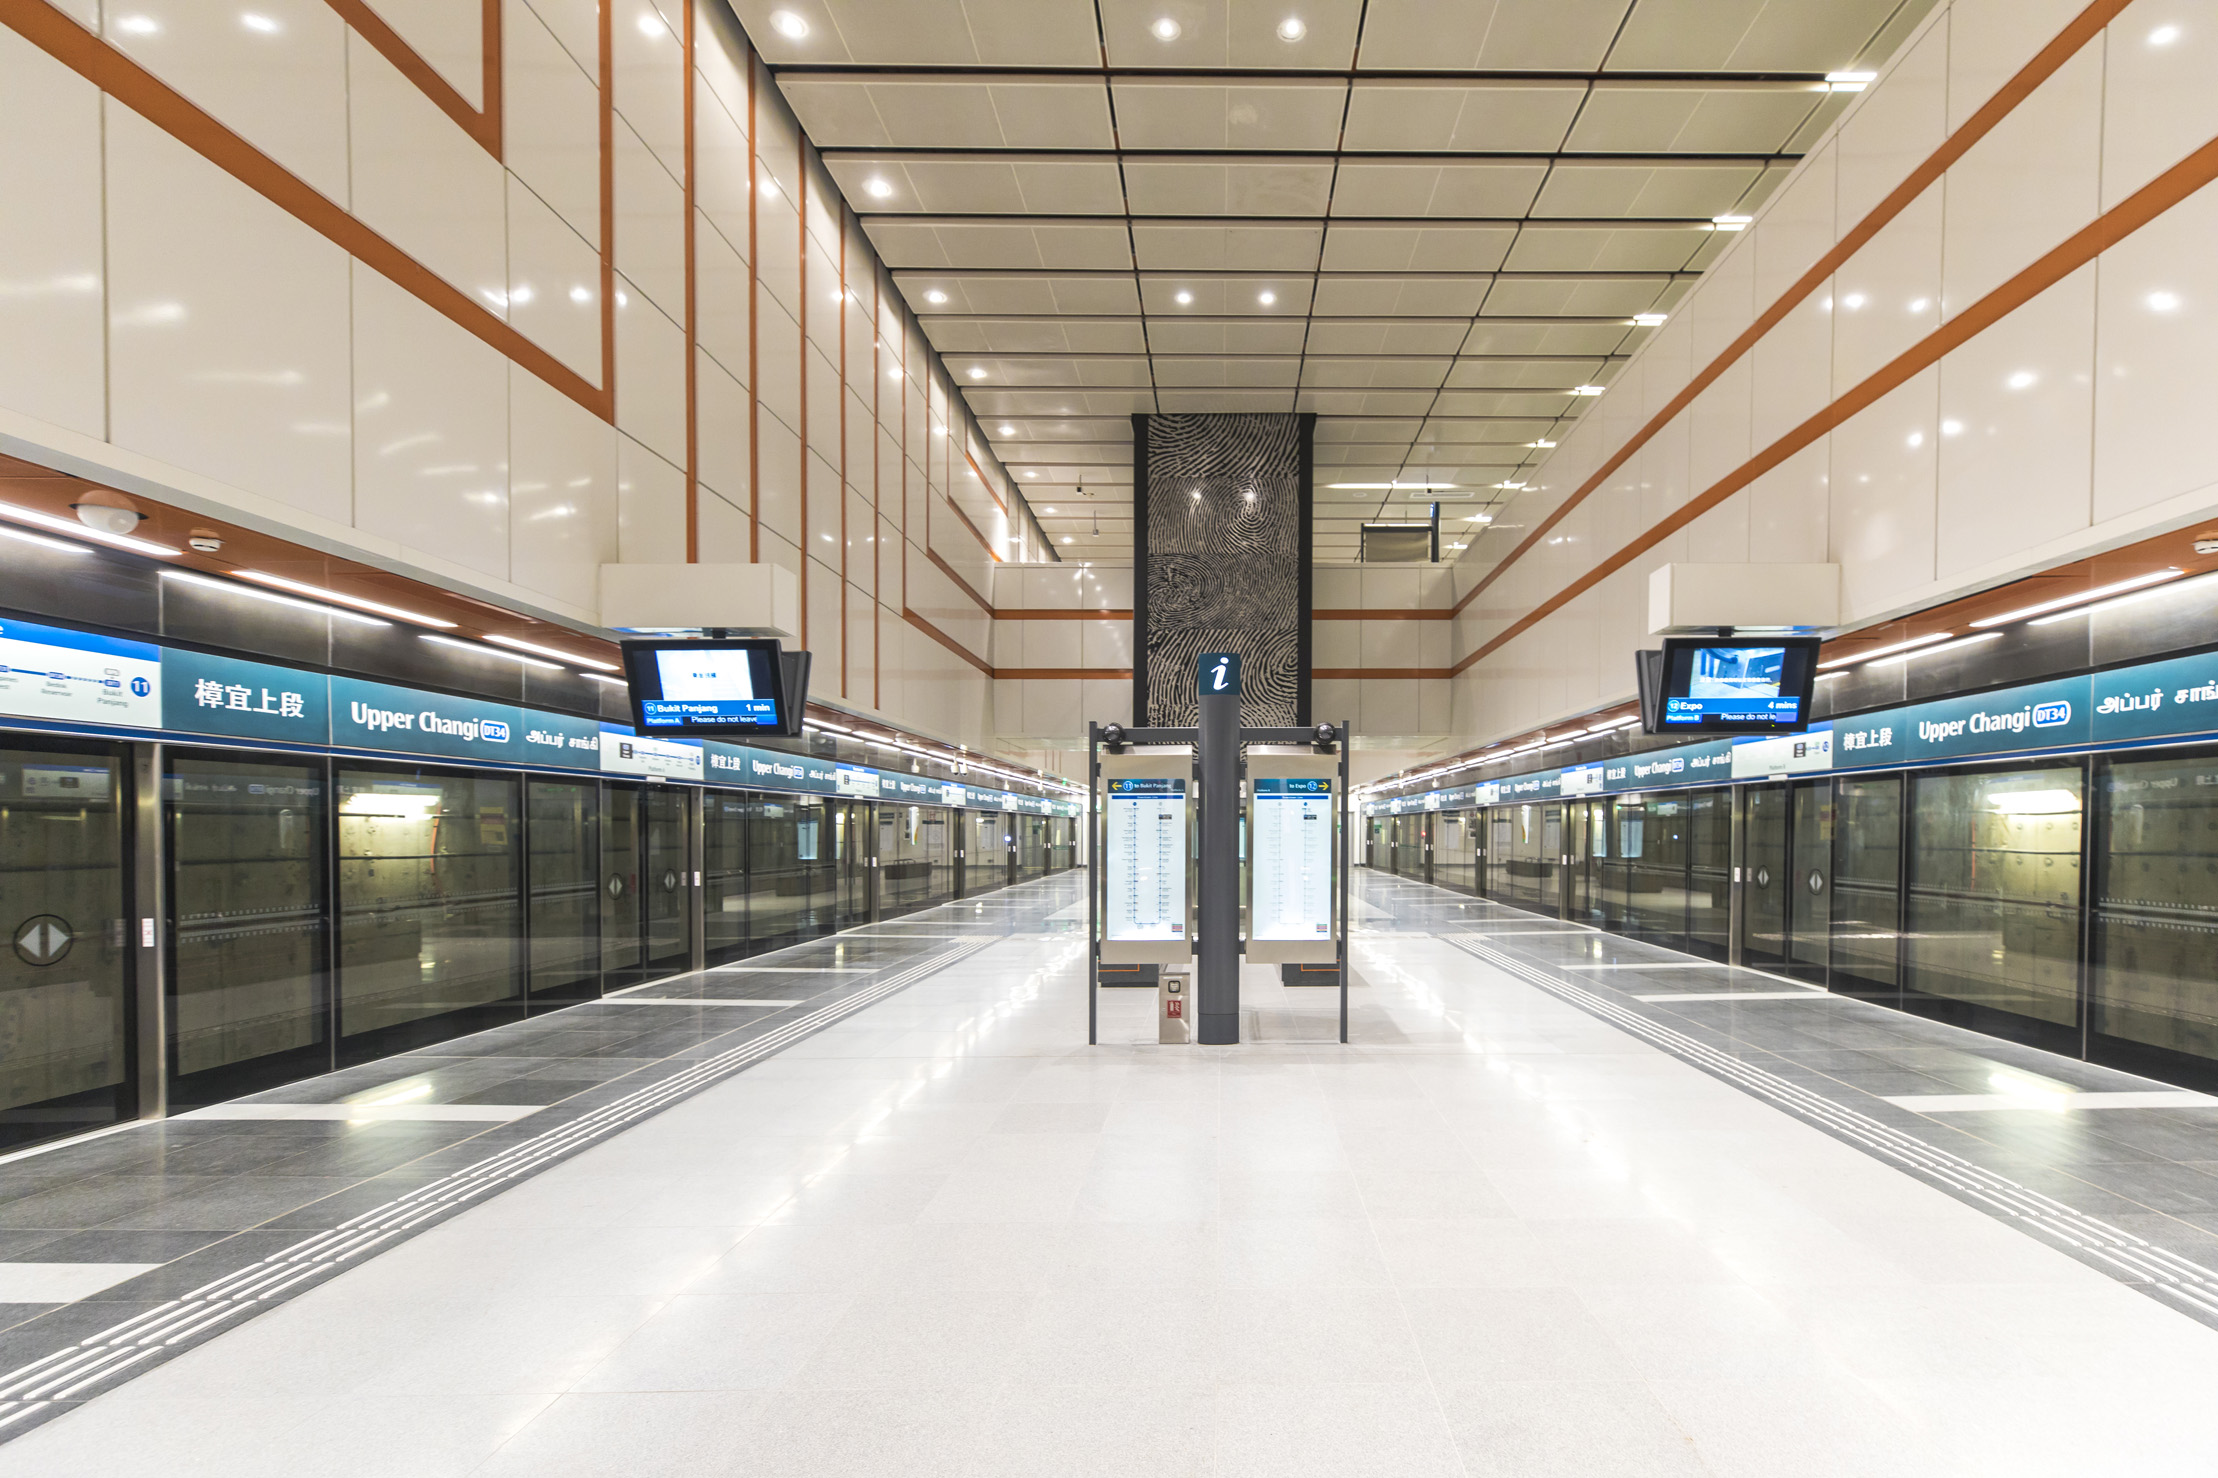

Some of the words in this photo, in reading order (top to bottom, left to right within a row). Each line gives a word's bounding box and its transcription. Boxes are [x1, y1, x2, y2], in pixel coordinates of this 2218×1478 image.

[131, 680, 148, 693] 11
[194, 678, 304, 718] 樟宜上段
[1680, 702, 1703, 711] Expo
[1767, 701, 1774, 709] 4
[1775, 701, 1797, 709] mins
[657, 704, 680, 713] Bukit
[682, 704, 718, 714] Panjang
[1721, 712, 1744, 720] Please
[351, 701, 415, 732] Upper
[419, 711, 479, 741] Changi
[483, 724, 506, 738] DT34
[1919, 720, 1966, 743] Upper
[1969, 705, 2031, 733] Changi
[2036, 707, 2066, 722] DT34
[1843, 727, 1893, 750] 樟宜上段
[752, 760, 773, 775] Upper
[773, 763, 794, 779] Changi
[1634, 765, 1651, 778] Upper
[1651, 759, 1672, 775] Changi
